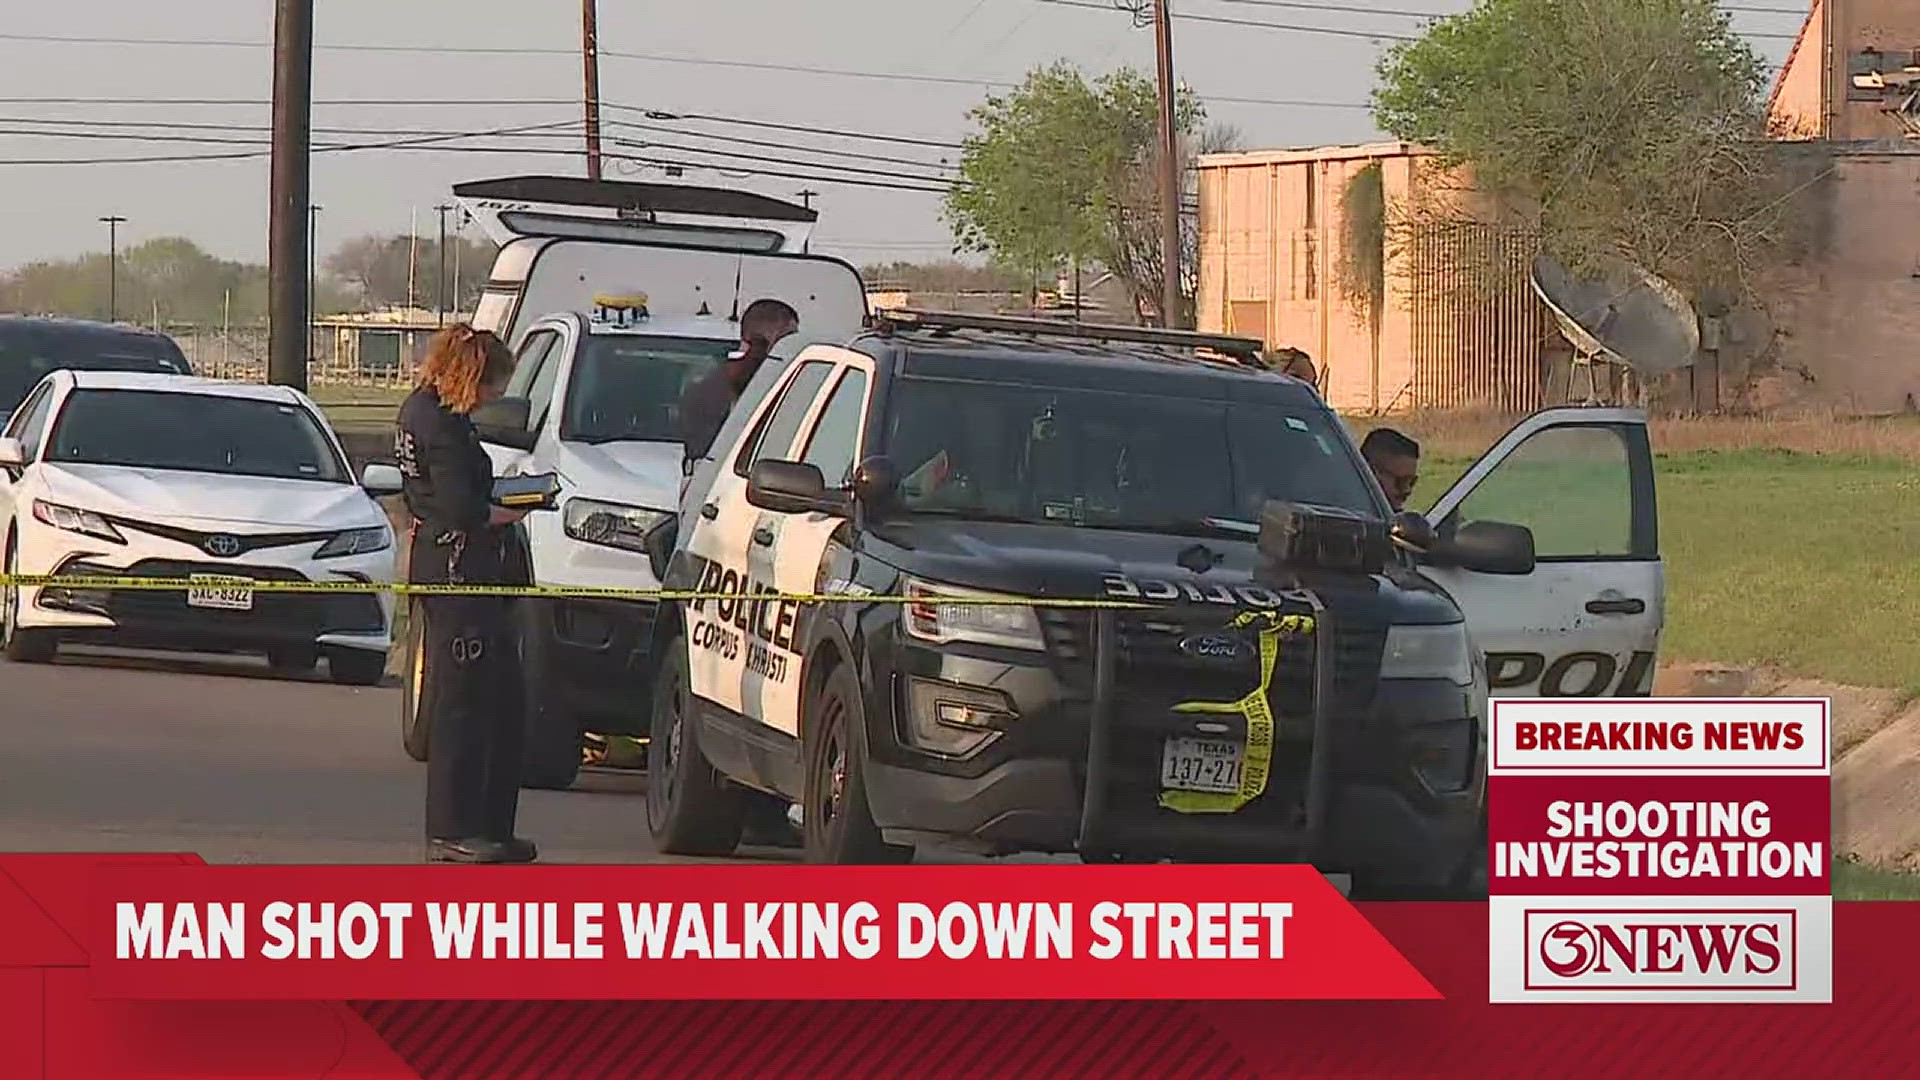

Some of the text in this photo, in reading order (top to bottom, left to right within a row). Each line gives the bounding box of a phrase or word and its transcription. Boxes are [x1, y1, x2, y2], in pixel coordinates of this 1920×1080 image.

[694, 558, 793, 650] POLICE
[693, 620, 788, 683] CORPUS CHRISTI
[1197, 741, 1236, 755] TEXAS
